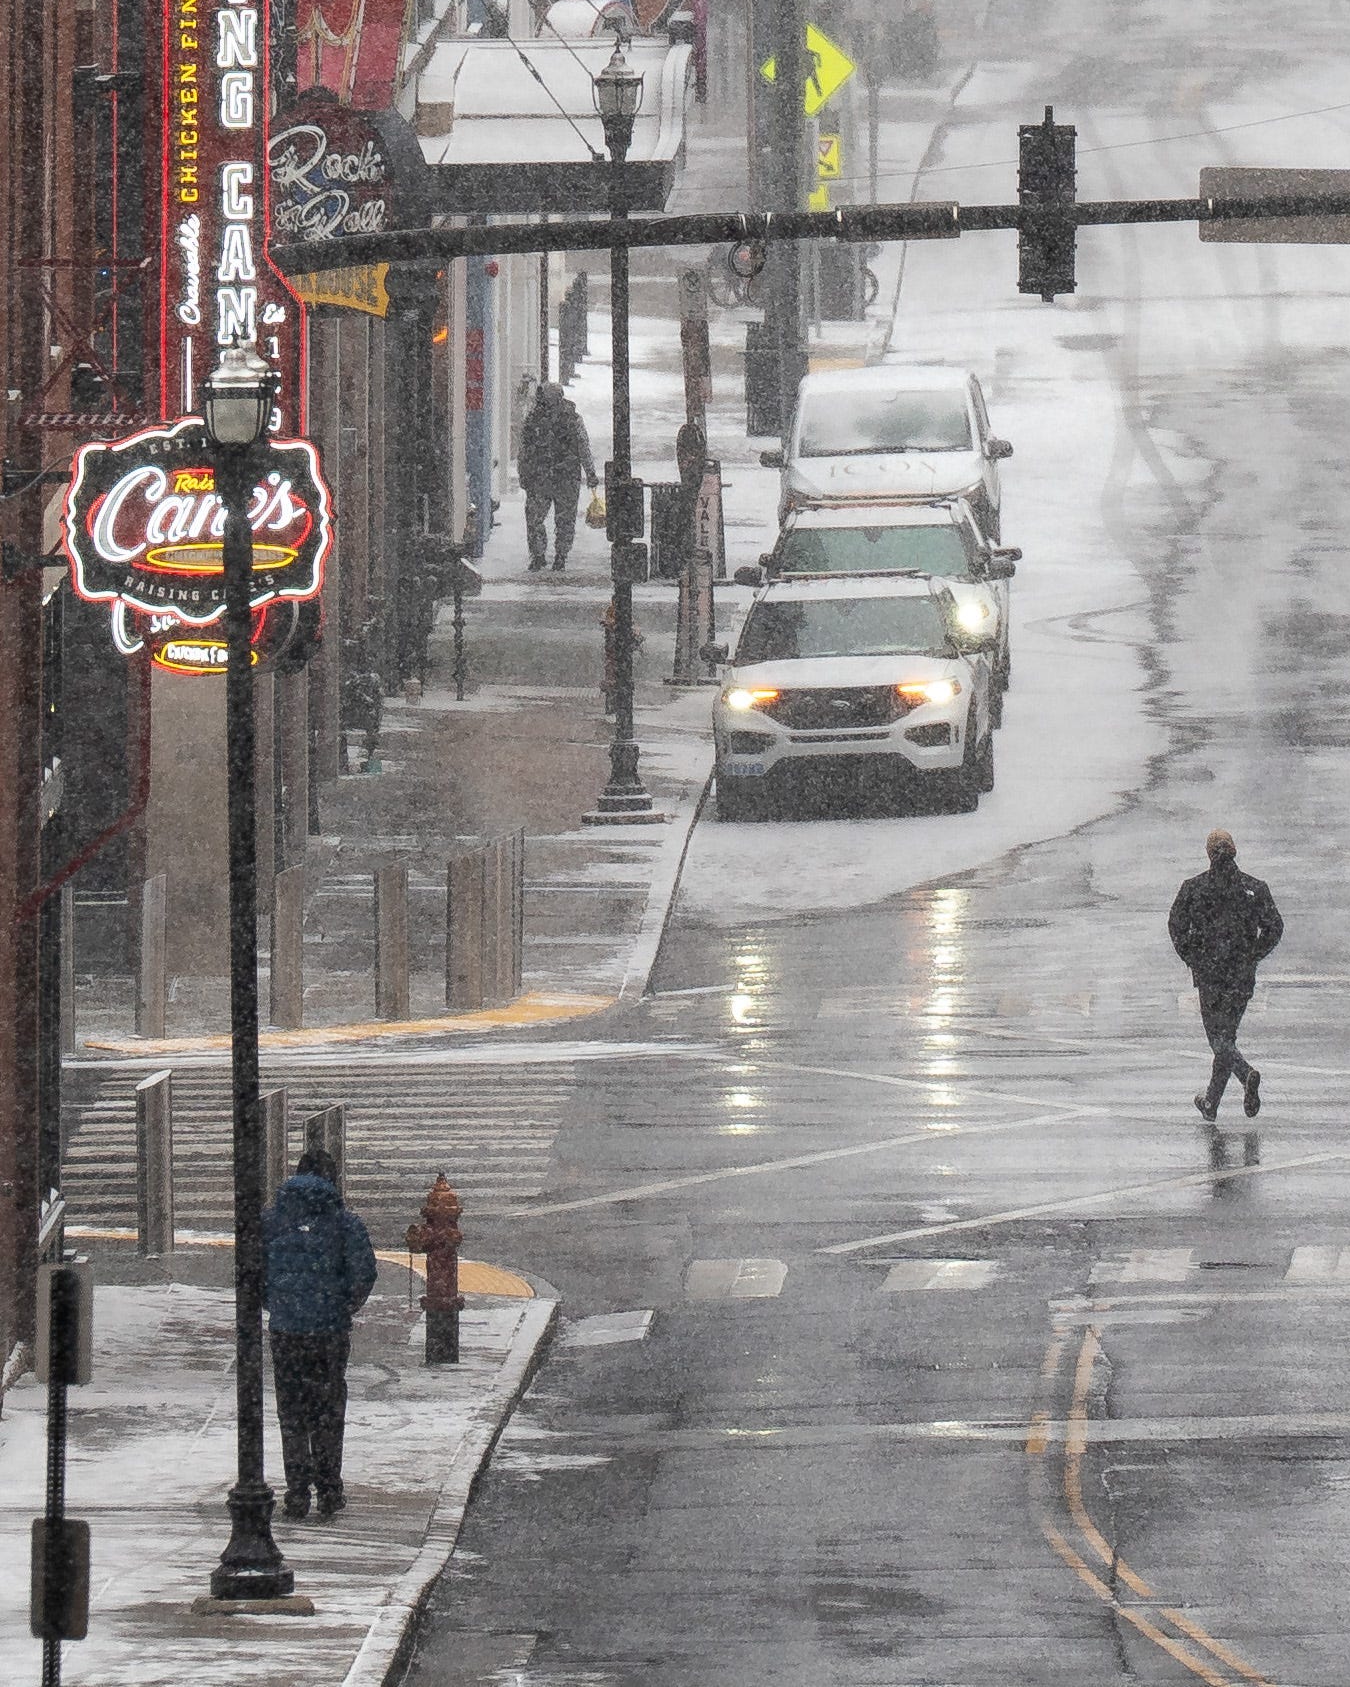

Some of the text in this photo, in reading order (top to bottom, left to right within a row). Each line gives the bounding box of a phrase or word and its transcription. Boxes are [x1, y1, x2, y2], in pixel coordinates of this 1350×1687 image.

[180, 63, 198, 204] CHICKEN
[267, 124, 385, 194] Rock
[217, 162, 258, 362] CAN
[174, 474, 215, 493] Rais
[700, 497, 711, 548] VALE
[124, 576, 200, 602] RAISING
